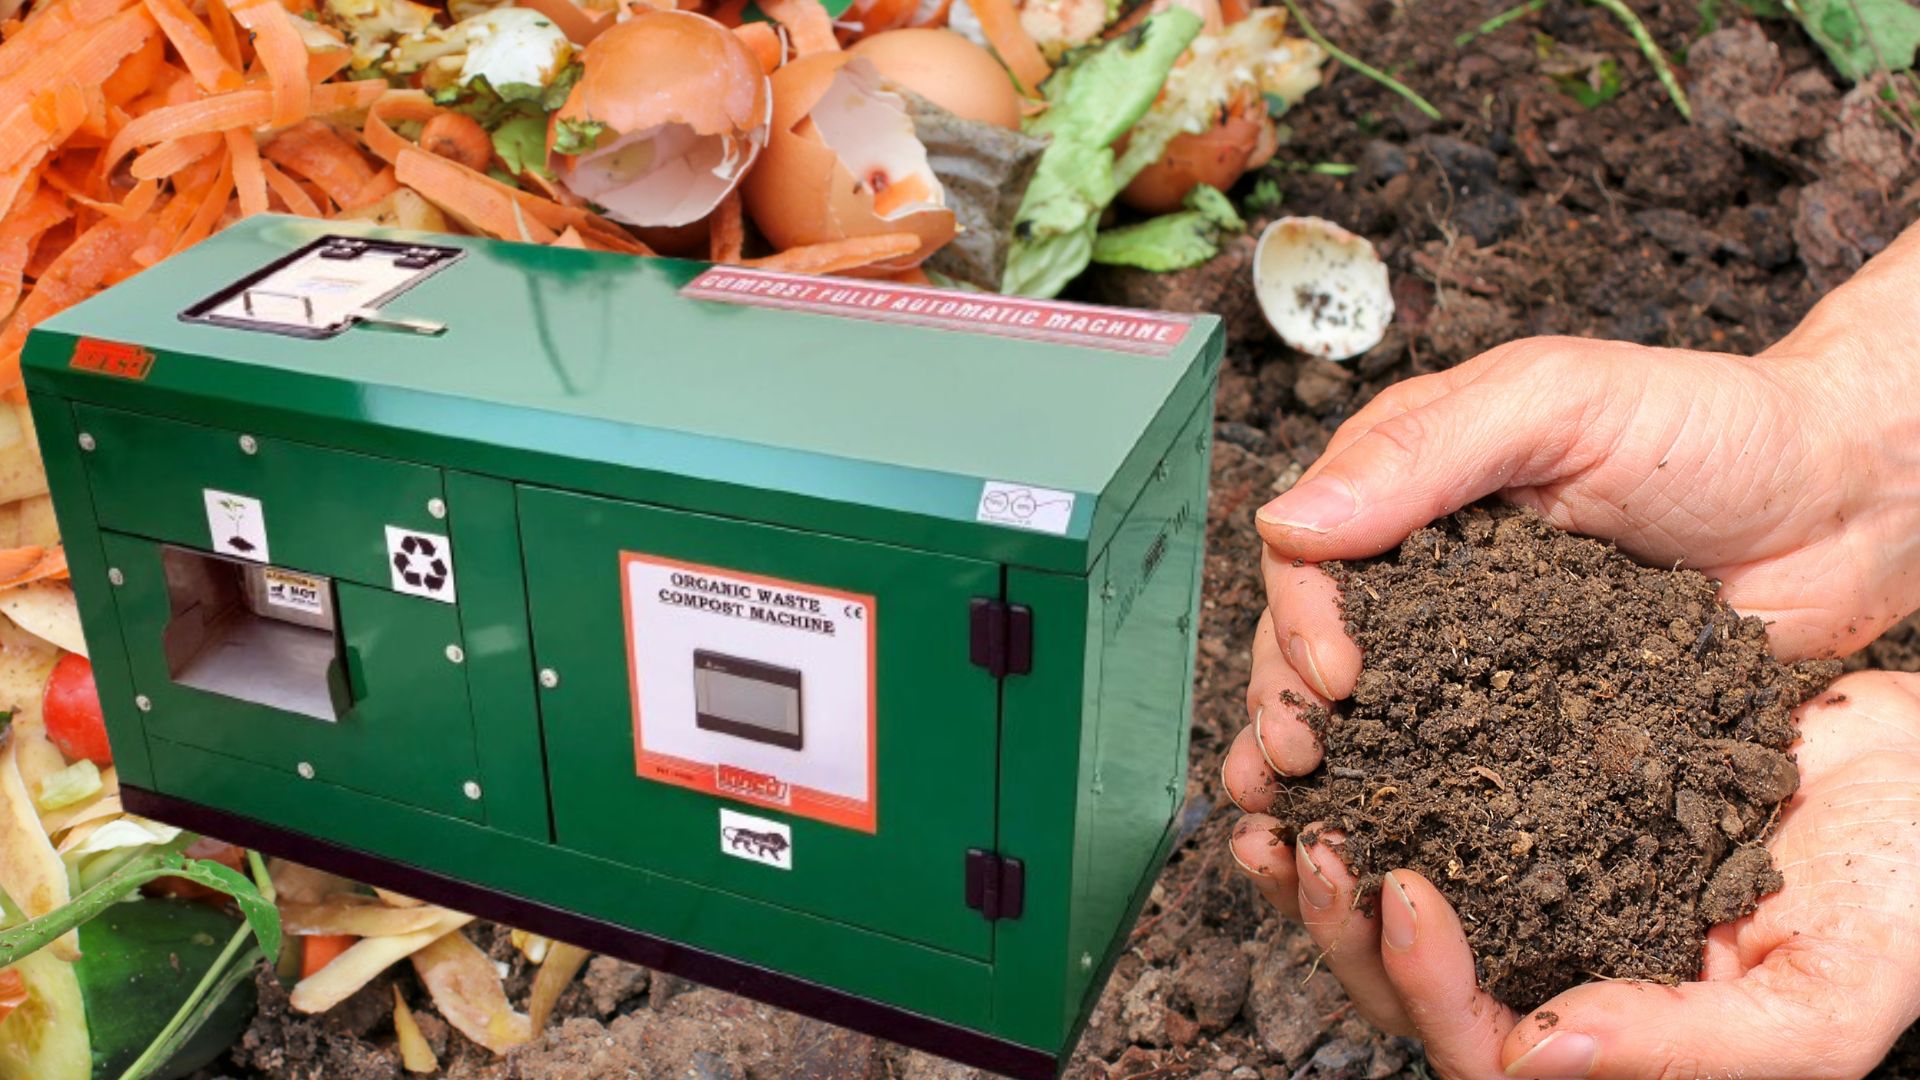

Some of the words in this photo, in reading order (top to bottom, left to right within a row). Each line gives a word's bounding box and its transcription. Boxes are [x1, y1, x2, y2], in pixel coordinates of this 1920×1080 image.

[700, 275, 815, 298] COMPOST
[815, 288, 891, 306] FULLY
[890, 296, 1039, 325] AUTOMATIC
[1045, 313, 1173, 341] MACHINE
[659, 588, 744, 616] COMPOST
[750, 607, 835, 633] MACHINE
[670, 572, 752, 598] ORGANIC
[757, 588, 821, 612] WASTE
